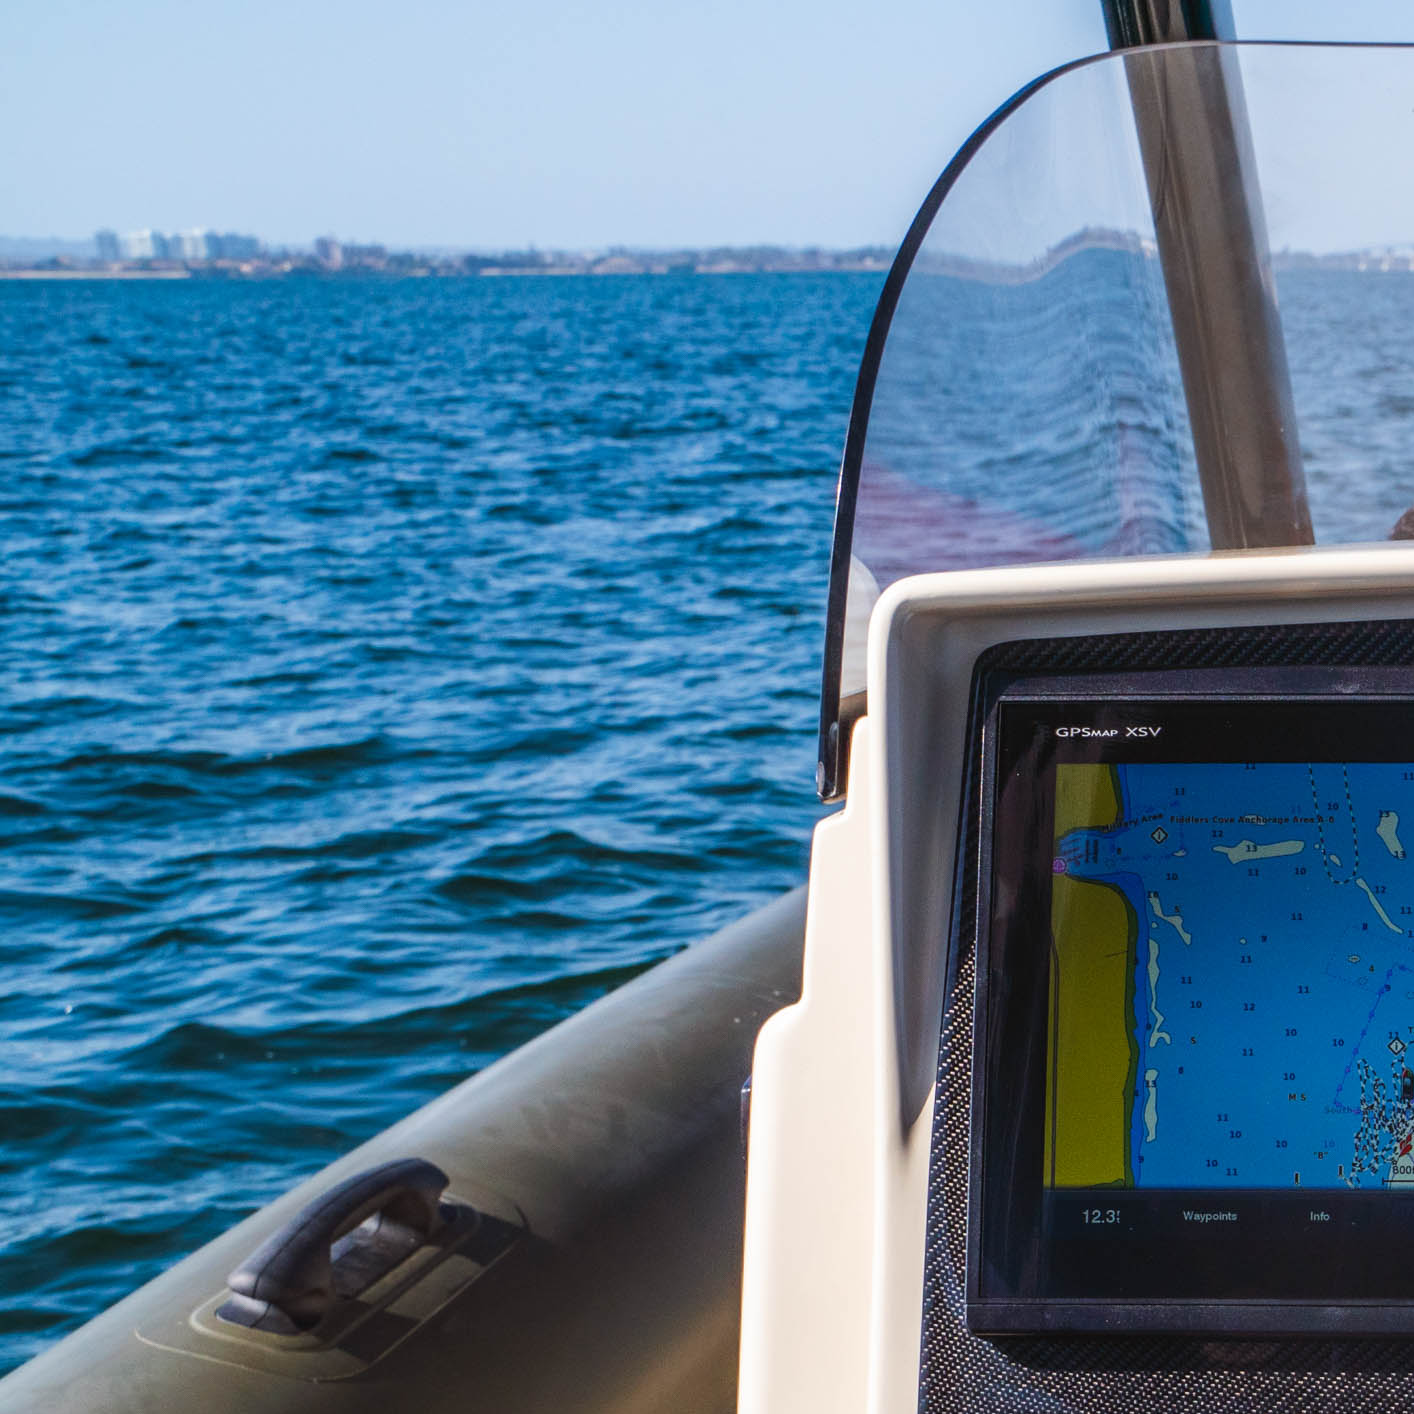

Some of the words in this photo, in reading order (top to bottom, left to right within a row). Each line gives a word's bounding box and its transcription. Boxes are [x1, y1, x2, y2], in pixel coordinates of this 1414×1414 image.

[1125, 727, 1161, 738] XSV
[1183, 1211, 1237, 1222] Waypoints
[1309, 1210, 1331, 1221] Info
